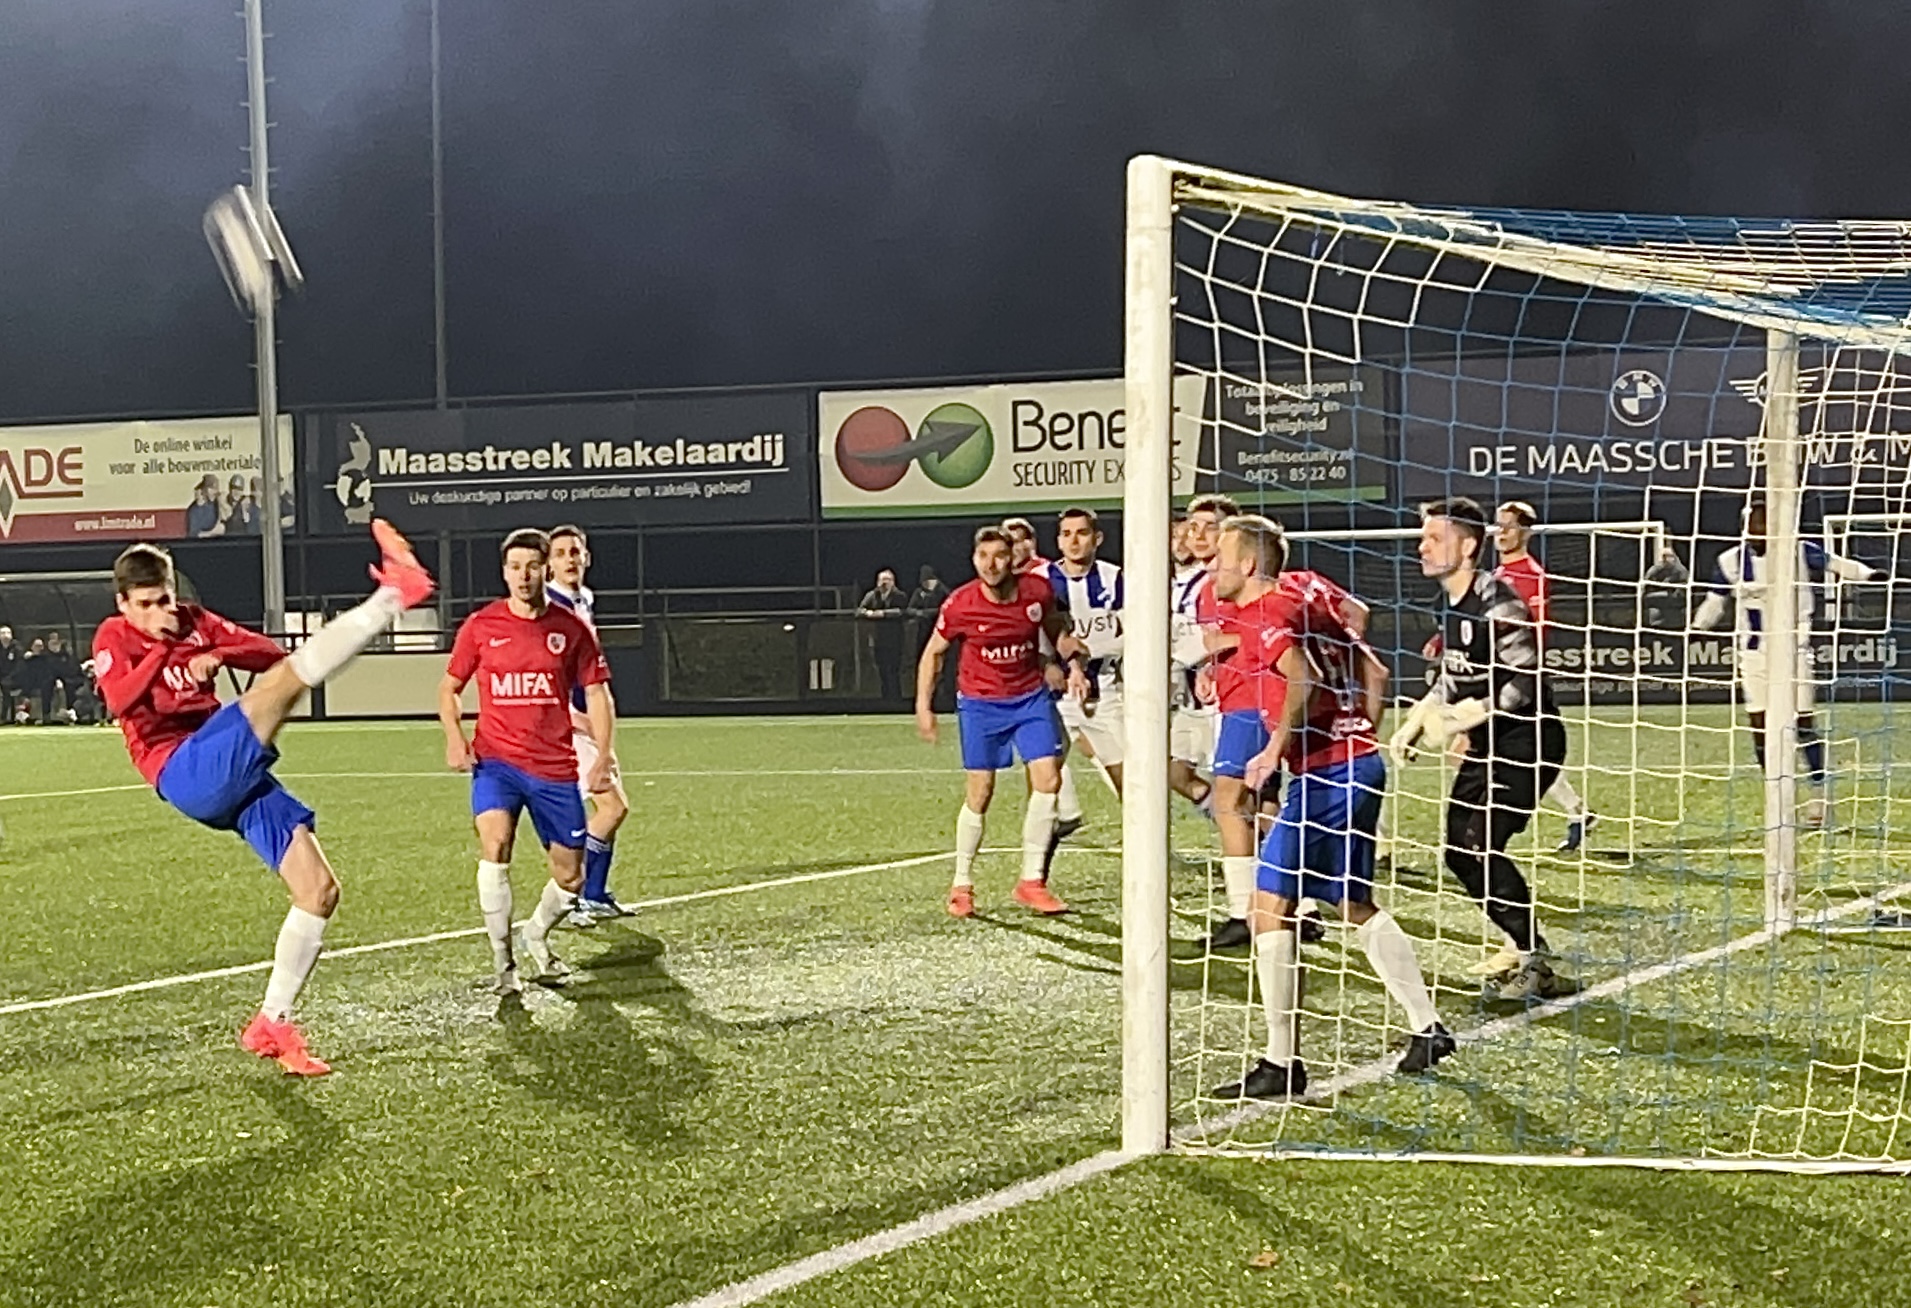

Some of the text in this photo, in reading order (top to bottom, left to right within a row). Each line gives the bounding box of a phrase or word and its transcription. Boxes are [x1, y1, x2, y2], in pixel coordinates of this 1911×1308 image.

[1245, 401, 1320, 416] beeiliging
[134, 434, 233, 454] De online winkel
[378, 434, 784, 476] Maasstreek Makelaardij
[1469, 446, 1518, 477] DE
[1527, 440, 1735, 475] MAASSCHE
[1746, 434, 1839, 468] BW
[109, 454, 262, 475] voor alle bouwmateriale
[1013, 460, 1096, 487] SECURITY
[1289, 467, 1307, 481] 85
[1311, 466, 1326, 480] 22
[1329, 466, 1346, 479] 40
[409, 492, 429, 505] Uw
[552, 489, 568, 502] op
[634, 486, 651, 497] en
[1544, 638, 1897, 668] sstreek Maardij
[490, 671, 554, 697] MIFA
